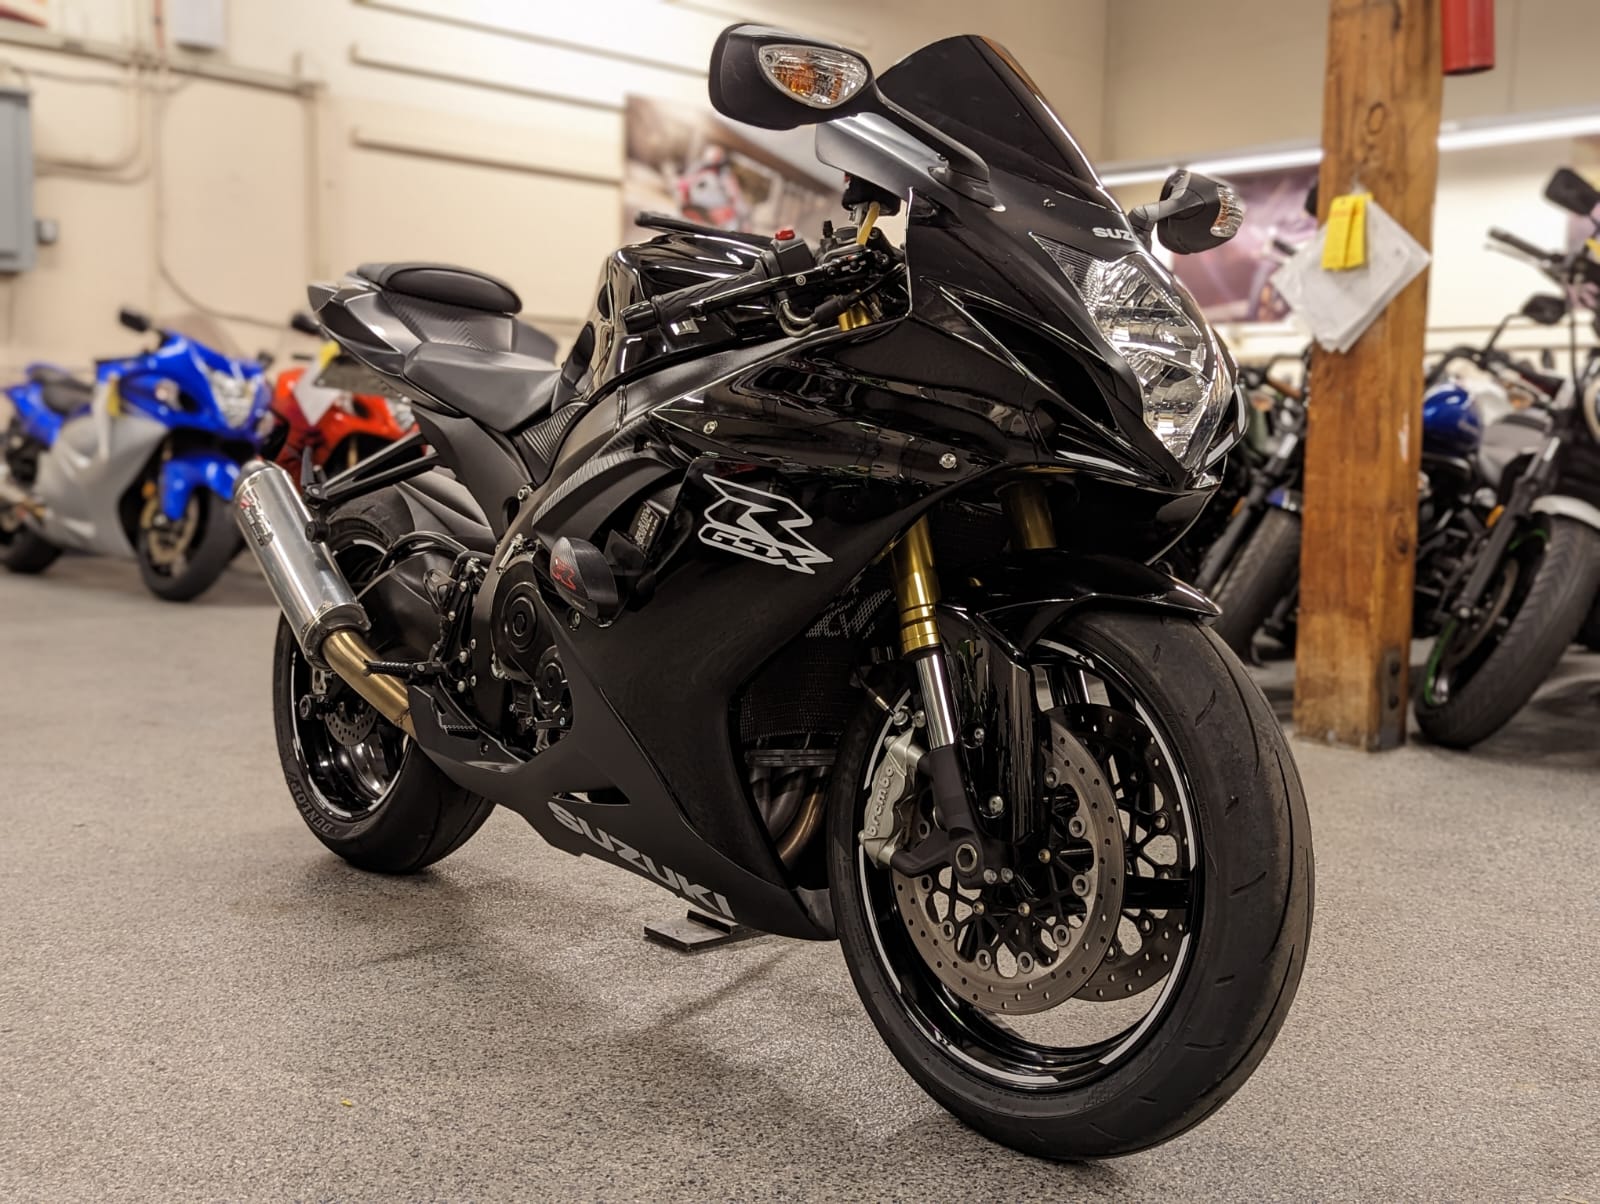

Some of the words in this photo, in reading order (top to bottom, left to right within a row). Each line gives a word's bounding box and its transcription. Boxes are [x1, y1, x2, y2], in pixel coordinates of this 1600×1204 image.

[698, 523, 816, 575] GSX
[290, 782, 334, 832] DUNLOP
[867, 765, 894, 837] brembo
[548, 801, 736, 920] SUZUKI
